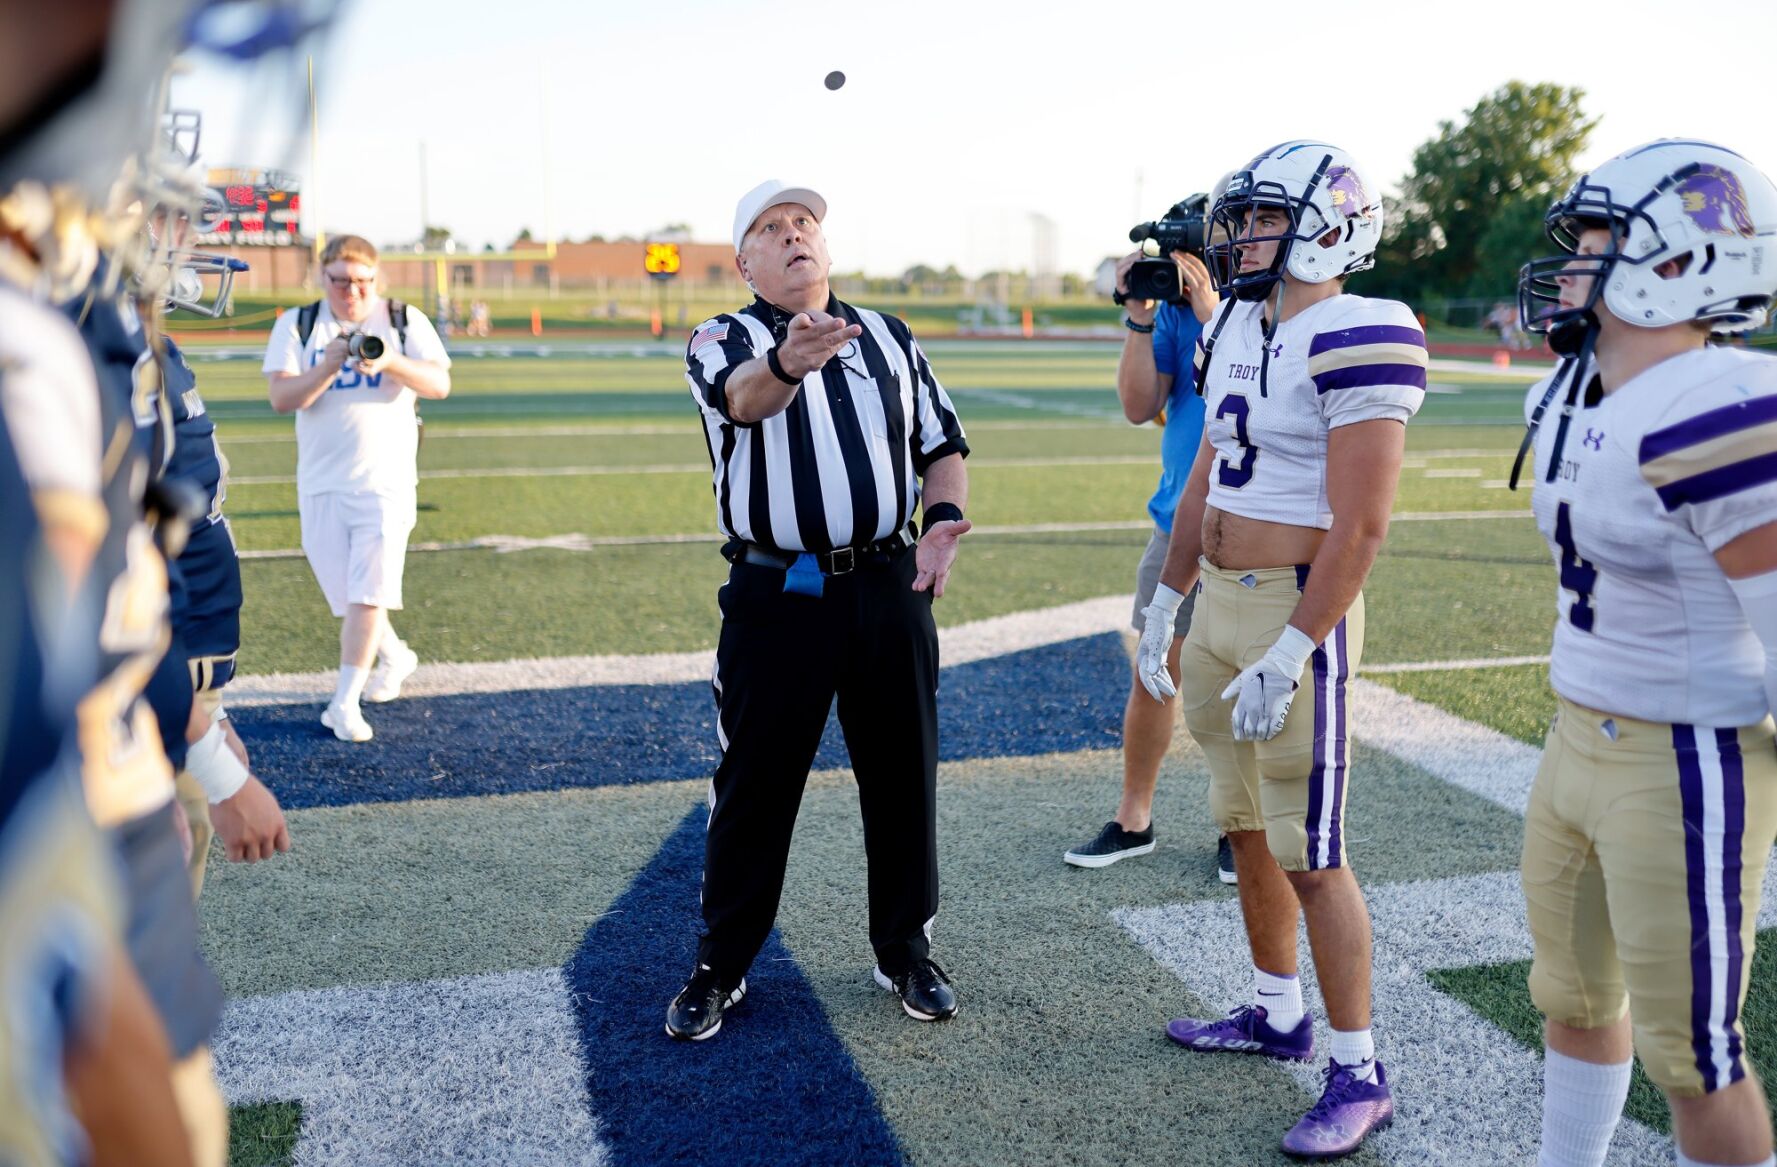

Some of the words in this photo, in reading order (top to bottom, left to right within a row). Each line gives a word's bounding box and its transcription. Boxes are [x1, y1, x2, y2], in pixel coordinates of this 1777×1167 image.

[1228, 363, 1260, 381] TROY
[1215, 391, 1260, 491] 3
[1558, 458, 1581, 483] ROY
[1554, 500, 1599, 634] 4
